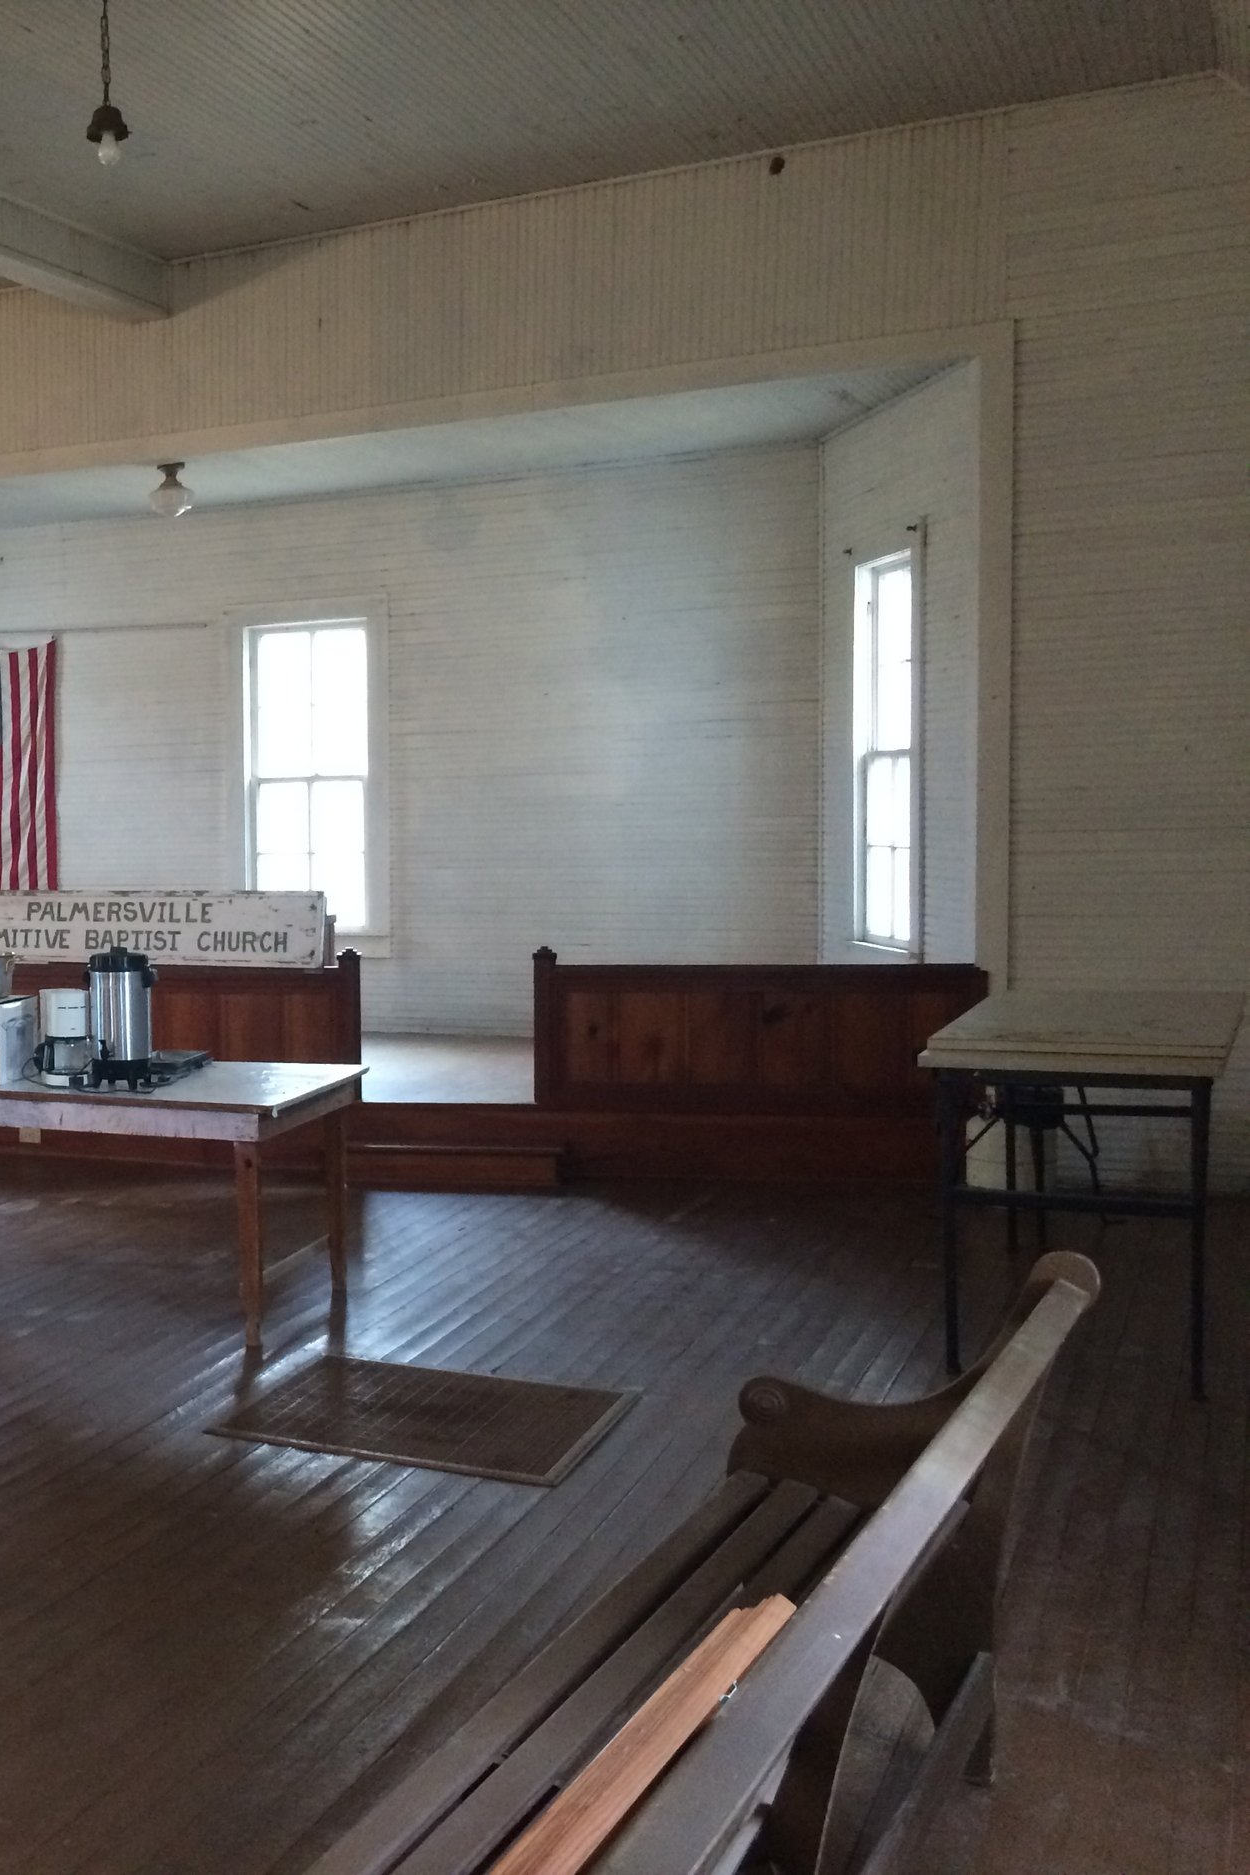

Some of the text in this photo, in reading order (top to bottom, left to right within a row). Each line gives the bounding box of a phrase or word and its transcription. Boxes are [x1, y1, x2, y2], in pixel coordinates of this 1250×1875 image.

[27, 901, 214, 923] PALMERSVILLE
[84, 929, 181, 951] BAPTIST
[196, 931, 288, 953] CHURCH
